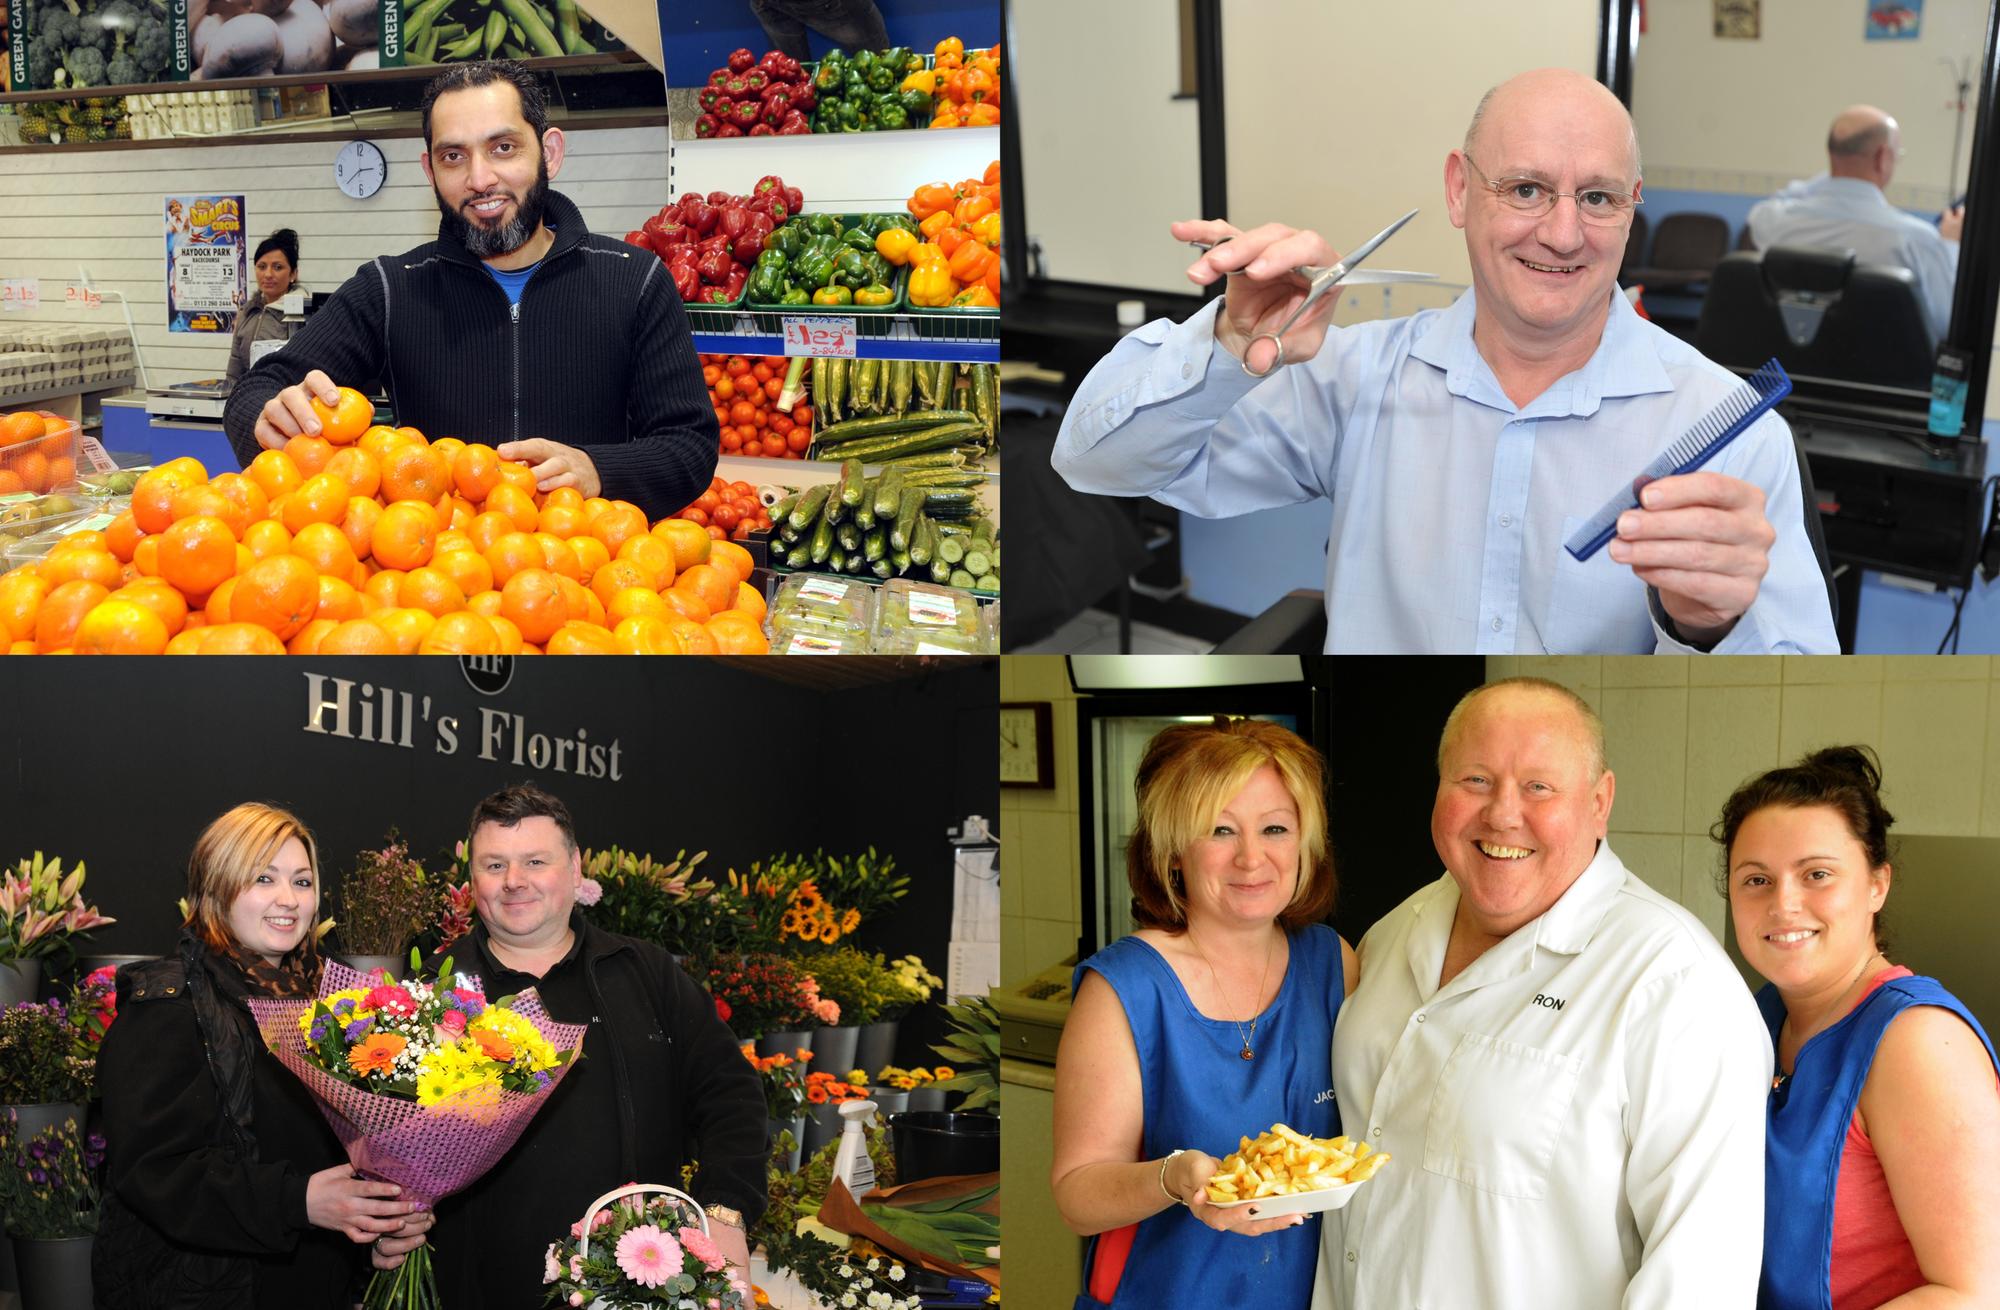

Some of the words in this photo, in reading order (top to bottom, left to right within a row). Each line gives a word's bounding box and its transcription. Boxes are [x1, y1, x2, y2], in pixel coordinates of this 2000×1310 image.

[385, 0, 399, 58] GREEN
[175, 18, 188, 72] GREEN
[13, 33, 26, 84] GREEN
[356, 144, 364, 156] 12
[338, 164, 343, 177] 9
[359, 184, 363, 196] 6
[181, 247, 211, 257] HAYDOCK
[213, 248, 231, 257] PARK
[192, 256, 220, 264] RACECOURSE
[182, 267, 188, 276] 8
[222, 268, 234, 276] 13
[303, 672, 459, 754] Hill's
[477, 707, 623, 781] Florist
[1532, 993, 1566, 1011] RON
